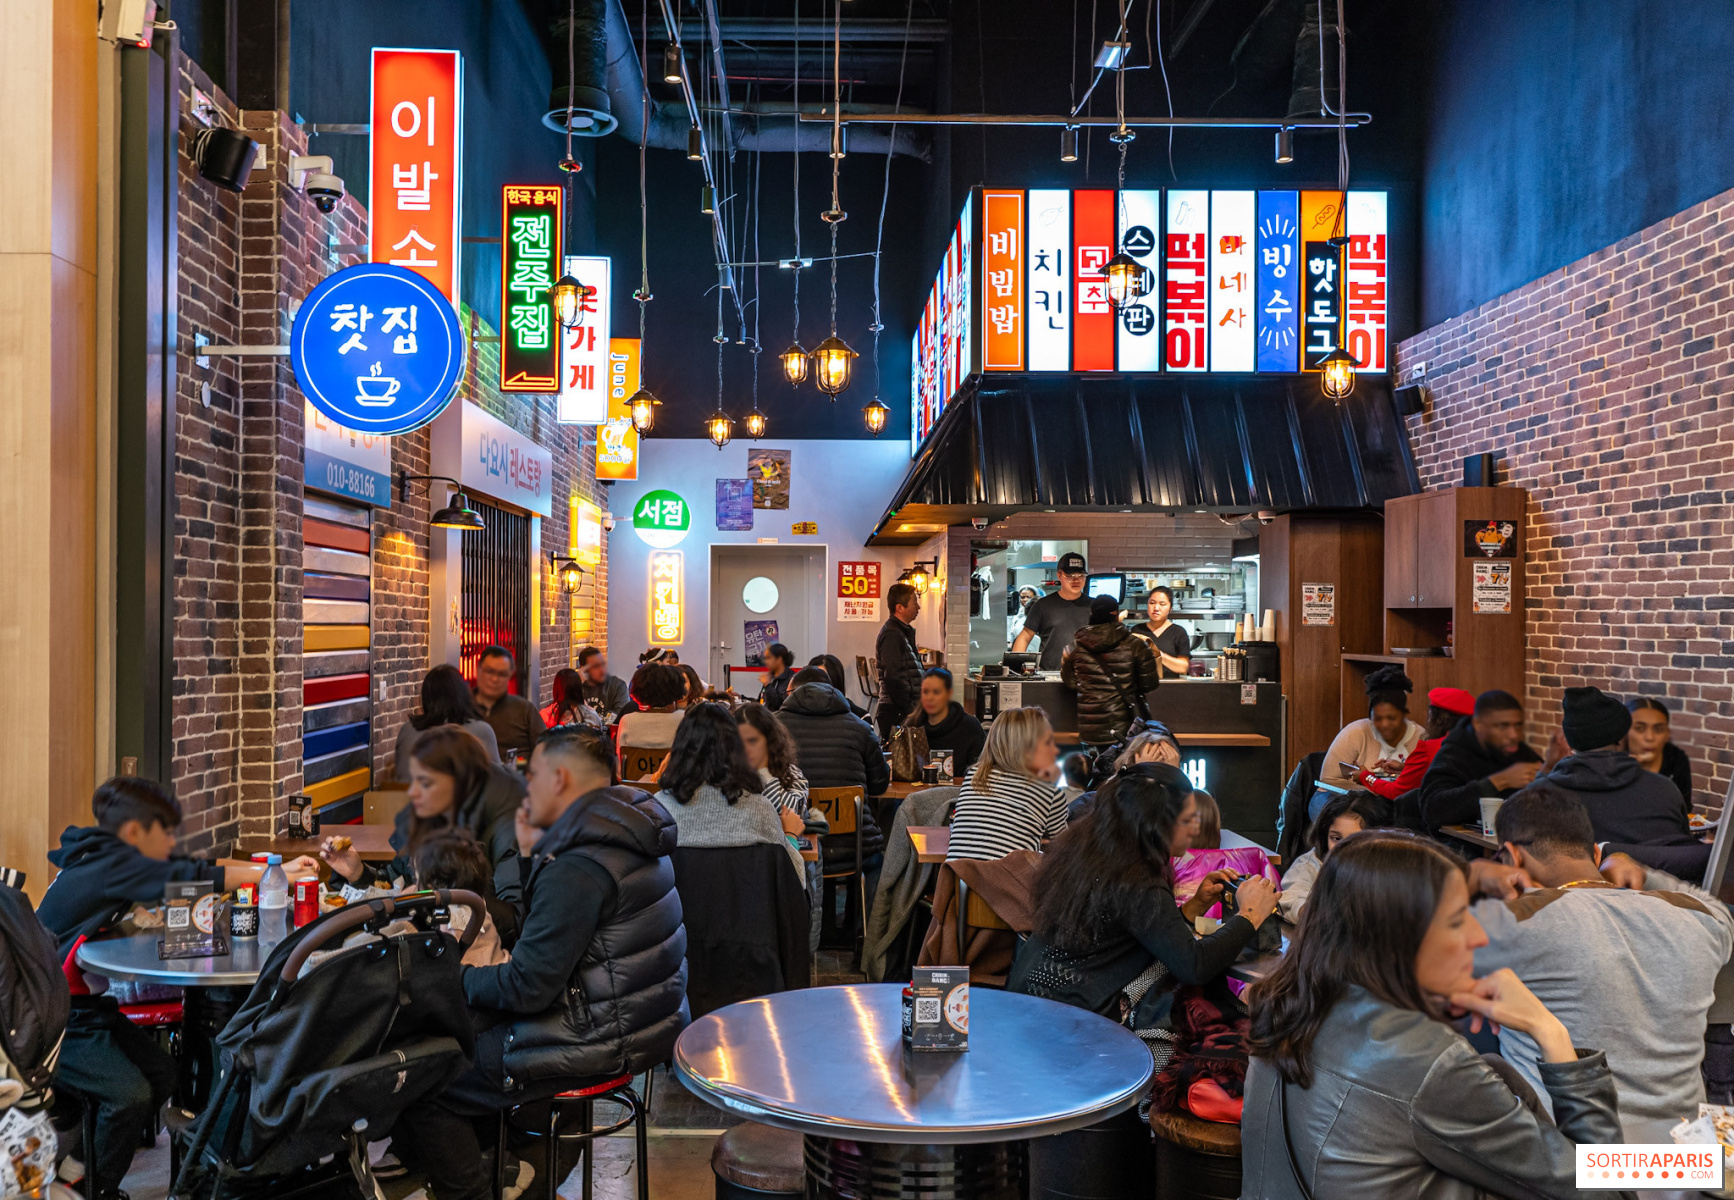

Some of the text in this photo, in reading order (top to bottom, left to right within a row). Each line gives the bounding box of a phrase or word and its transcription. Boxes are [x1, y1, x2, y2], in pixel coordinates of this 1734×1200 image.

[391, 96, 439, 267] 이발소
[507, 189, 557, 205] 한국 음식
[510, 215, 551, 349] 전주집
[988, 228, 1019, 335] 비빔밥
[1034, 248, 1064, 330] 치킨
[1079, 248, 1110, 313] 고추
[1166, 233, 1205, 368] 떡볶이
[1262, 244, 1293, 323] 빙수
[1306, 257, 1337, 353] 핫도그
[1349, 234, 1386, 369] 떡볶이
[329, 303, 419, 355] 찻집
[610, 352, 629, 398] june
[326, 462, 375, 498] 010-88166
[480, 430, 542, 498] 다요시 레스토랑
[638, 499, 683, 526] 서점
[653, 554, 680, 640] 치킨뱅
